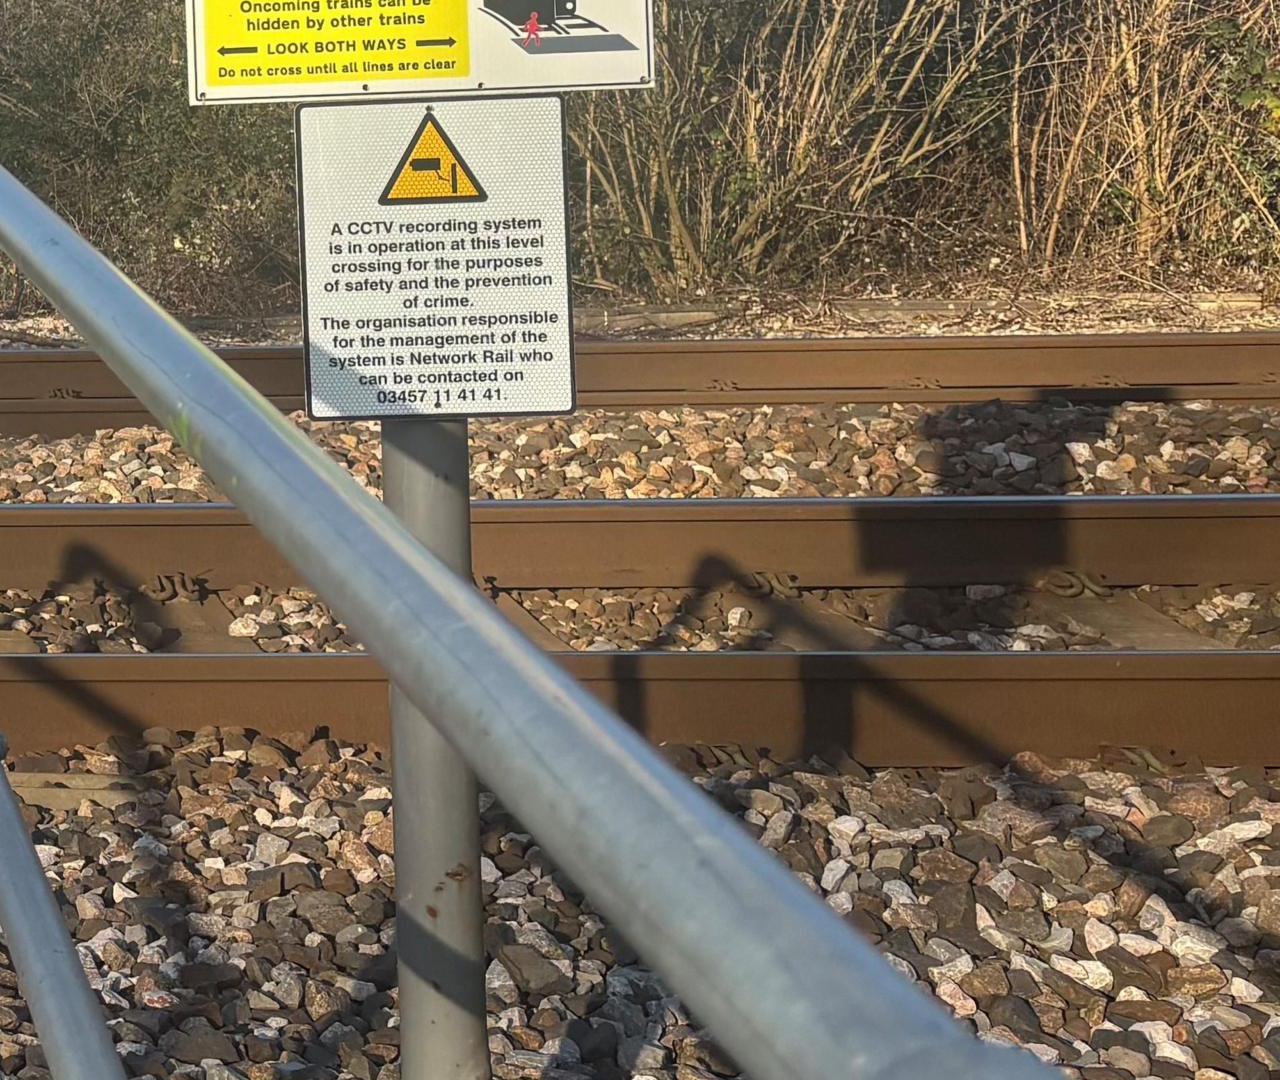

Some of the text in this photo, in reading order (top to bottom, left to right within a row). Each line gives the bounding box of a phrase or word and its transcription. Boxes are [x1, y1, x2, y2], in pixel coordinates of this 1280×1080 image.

[247, 11, 425, 32] hidden by other trains
[266, 37, 407, 55] LOOK BOTH WAYS
[218, 57, 456, 79] Do not cross until all lines are clear
[331, 217, 542, 236] A CCTV recording system
[329, 235, 544, 255] is in operation at this level
[332, 257, 543, 274] crossing for the purposes
[324, 274, 552, 295] of safety and the prevention
[403, 294, 474, 309] of crime.
[320, 312, 558, 331] The organisation responsible
[333, 330, 547, 348] for the management of the
[329, 349, 553, 370] system is Network Rail who
[359, 369, 524, 386] can be contacted on
[377, 387, 508, 404] 03457 11 41 41.
